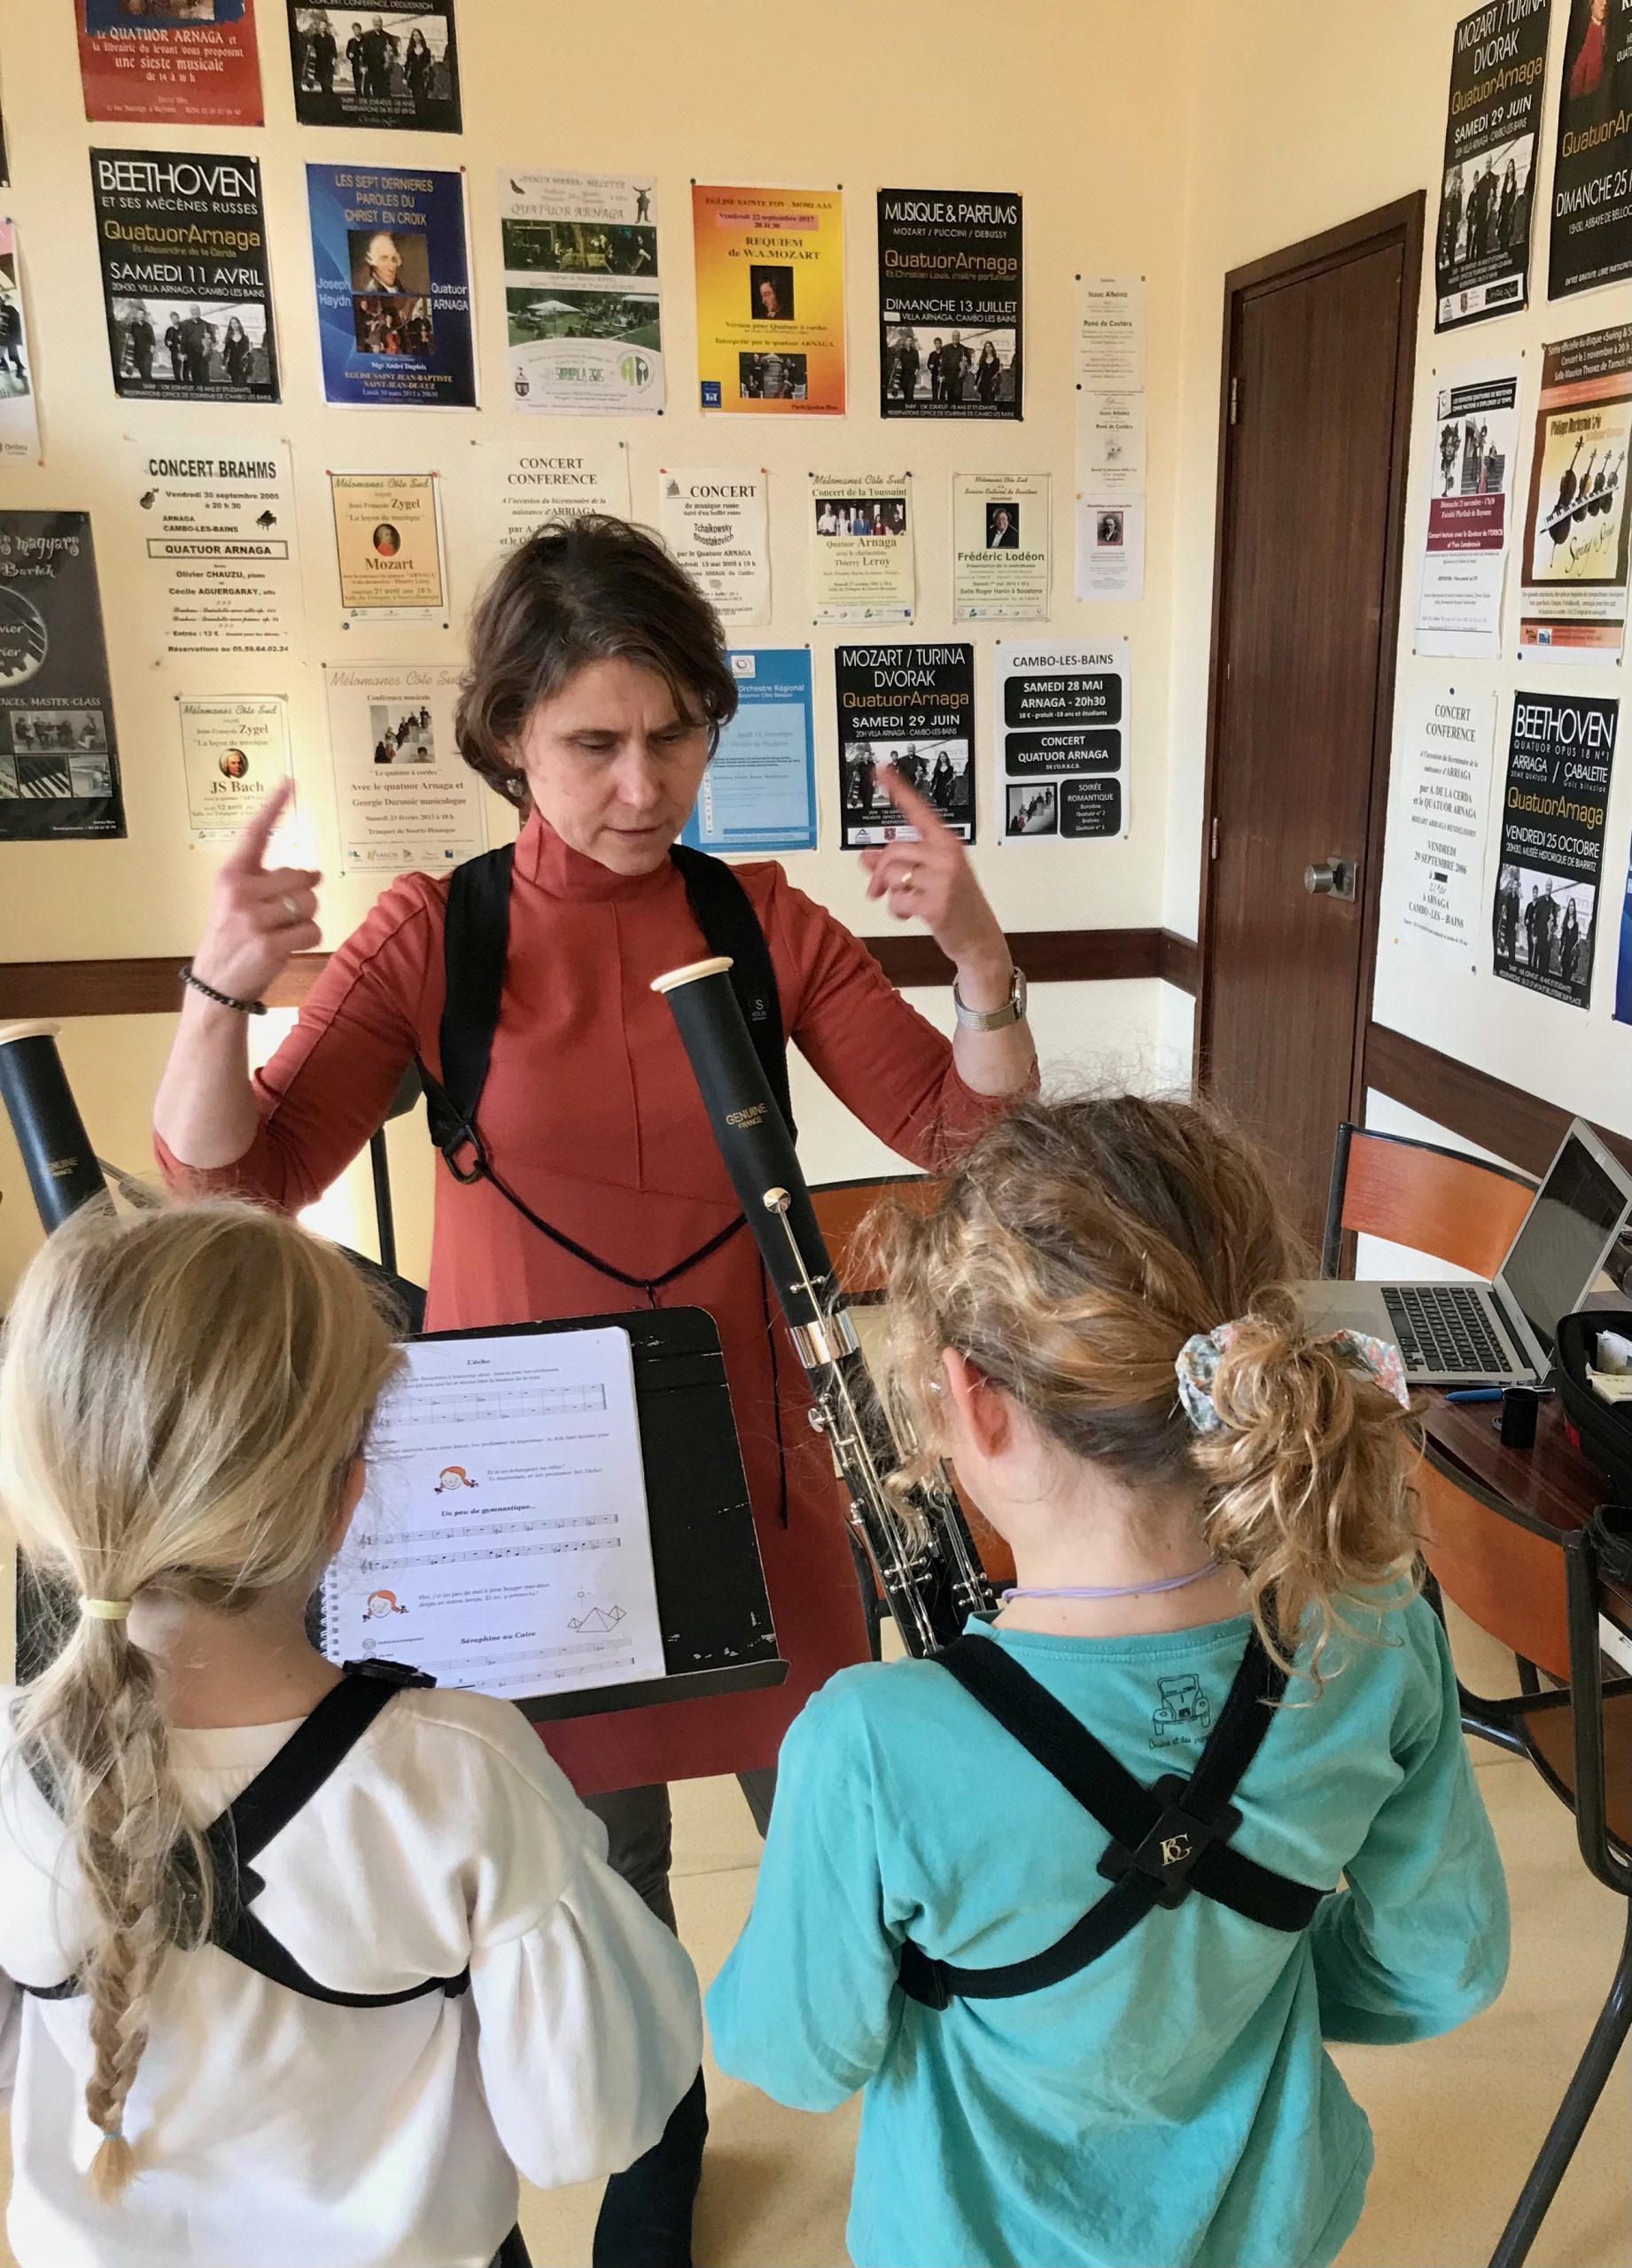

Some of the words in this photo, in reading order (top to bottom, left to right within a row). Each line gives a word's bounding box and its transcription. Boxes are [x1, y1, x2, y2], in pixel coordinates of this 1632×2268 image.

[110, 27, 168, 42] QUATUOR
[175, 29, 223, 44] ARNAGA
[1457, 6, 1497, 53] MOZART
[1473, 27, 1520, 74] DVORAK
[141, 56, 170, 70] sieste
[177, 58, 223, 72] musicale
[1451, 57, 1543, 116] QuatuorArnaga
[1454, 113, 1488, 144] SAMEDI
[1491, 106, 1504, 127] 29
[1507, 94, 1533, 119] JUIN
[1562, 109, 1632, 157] QuatuorAr
[98, 160, 257, 198] BEETHOVEN
[336, 175, 353, 187] LES
[356, 176, 378, 189] SEPT
[356, 192, 398, 207] PAROLES
[401, 195, 415, 208] DU
[1556, 175, 1613, 218] DIMANCHE
[1613, 168, 1628, 198] 25
[102, 197, 115, 207] ET
[120, 198, 142, 209] SES
[146, 196, 208, 212] MÉCÈNES
[213, 202, 258, 215] RUSSES
[345, 209, 378, 221] CHRIST
[382, 212, 395, 222] EN
[399, 213, 427, 225] CROIX
[885, 202, 944, 223] MUSIQUE
[958, 204, 1017, 225] PARFUMS
[105, 221, 260, 252] QuatuorArnaga
[746, 235, 804, 248] REQUIEM
[893, 228, 927, 237] MOZART
[934, 229, 968, 238] PUCCINI
[975, 229, 1007, 240] DEBUSSY
[728, 248, 741, 258] de
[885, 250, 1018, 276] QuatuorArnaga
[111, 261, 183, 283] SAMEDI
[190, 266, 206, 284] 11
[214, 268, 264, 285] AVRIL
[198, 285, 229, 297] CAMBO
[318, 278, 350, 291] Joseph
[431, 283, 468, 295] Quatuor
[320, 293, 352, 309] Haydn
[433, 299, 469, 310] ARNAGA
[886, 299, 956, 313] DIMANCHE
[975, 301, 1018, 314] JUILLET
[956, 315, 984, 324] CAMBO
[997, 316, 1017, 325] BAINS
[1561, 353, 1579, 367] Concert
[149, 458, 214, 478] CONCERT
[219, 460, 277, 479] BRAHMS
[520, 457, 584, 470] CONCERT
[409, 478, 429, 489] Sud
[508, 473, 598, 485] CONFERENCE
[813, 475, 862, 486] Mélomanes
[886, 475, 905, 486] Sud
[166, 490, 202, 500] Vendredi
[215, 492, 259, 501] septembre
[690, 485, 758, 499] CONCERT
[812, 488, 844, 498] Concert
[846, 488, 858, 497] de
[869, 488, 907, 497] Toussaint
[391, 498, 420, 512] Zygel
[695, 502, 721, 511] musique
[163, 524, 238, 533] CAMBO-LES-BAINS
[165, 545, 221, 555] QUATUOR
[224, 546, 272, 555] ARNAGA
[857, 536, 898, 549] Arnaga
[365, 557, 414, 571] Mozart
[862, 556, 890, 568] Leroy
[958, 551, 1001, 562] Frédéric
[1006, 552, 1045, 562] Lodéon
[168, 646, 219, 655] Réservations
[843, 649, 903, 667] MOZART
[916, 648, 966, 665] TURINA
[1013, 654, 1114, 667] CAMBO-LES-BAINS
[330, 671, 399, 687] Mélomanes
[406, 671, 433, 687] Côte
[874, 670, 936, 687] DVORAK
[1023, 681, 1064, 694] SAMEDI
[1067, 680, 1080, 691] 28
[1082, 680, 1103, 690] MAI
[32, 697, 101, 707] MASTER-CLASS
[843, 691, 970, 710] QuatuorArnaga
[1021, 696, 1067, 710] ARNAGA
[1075, 695, 1107, 707] 20h30
[258, 705, 276, 715] Sud
[1434, 704, 1471, 721] CONCERT
[852, 716, 904, 728] SAMEDI
[909, 716, 926, 727] 29
[930, 714, 960, 726] JUIN
[1514, 704, 1614, 749] BEETHOVEN
[239, 725, 268, 738] Zygel
[1426, 722, 1476, 742] CONFERENCE
[1041, 735, 1086, 748] CONCERT
[1018, 752, 1066, 764] QUATUOR
[1067, 749, 1109, 761] ARNAGA
[1514, 740, 1551, 753] QUATUOR
[1555, 745, 1576, 757] OPUS
[1581, 749, 1591, 759] 18
[1512, 755, 1549, 774] ARRIAGA
[210, 781, 227, 795] JS
[231, 781, 264, 793] Bach
[422, 781, 453, 791] Arnaga
[1078, 782, 1102, 792] SOIRÉE
[1067, 793, 1114, 803] ROMANTIQUE
[1424, 798, 1453, 813] QUATUOR
[1507, 787, 1605, 830] QuatuorArnaga
[1505, 823, 1547, 847] VENDREDI
[1547, 832, 1557, 850] 25
[1558, 835, 1600, 859] OCTOBRE
[1427, 840, 1457, 858] VENDREDI
[1421, 853, 1455, 872] SEPTEMBRE
[1574, 857, 1597, 873] BIARRITZ
[1427, 895, 1450, 911] ARNAGA
[1445, 913, 1465, 929] BAINS
[756, 998, 764, 1011] S
[726, 1103, 769, 1127] GENUINE
[454, 1509, 469, 1518] peu
[461, 1634, 502, 1645] Séraphine
[503, 1633, 514, 1642] au
[514, 1630, 536, 1640] Caire
